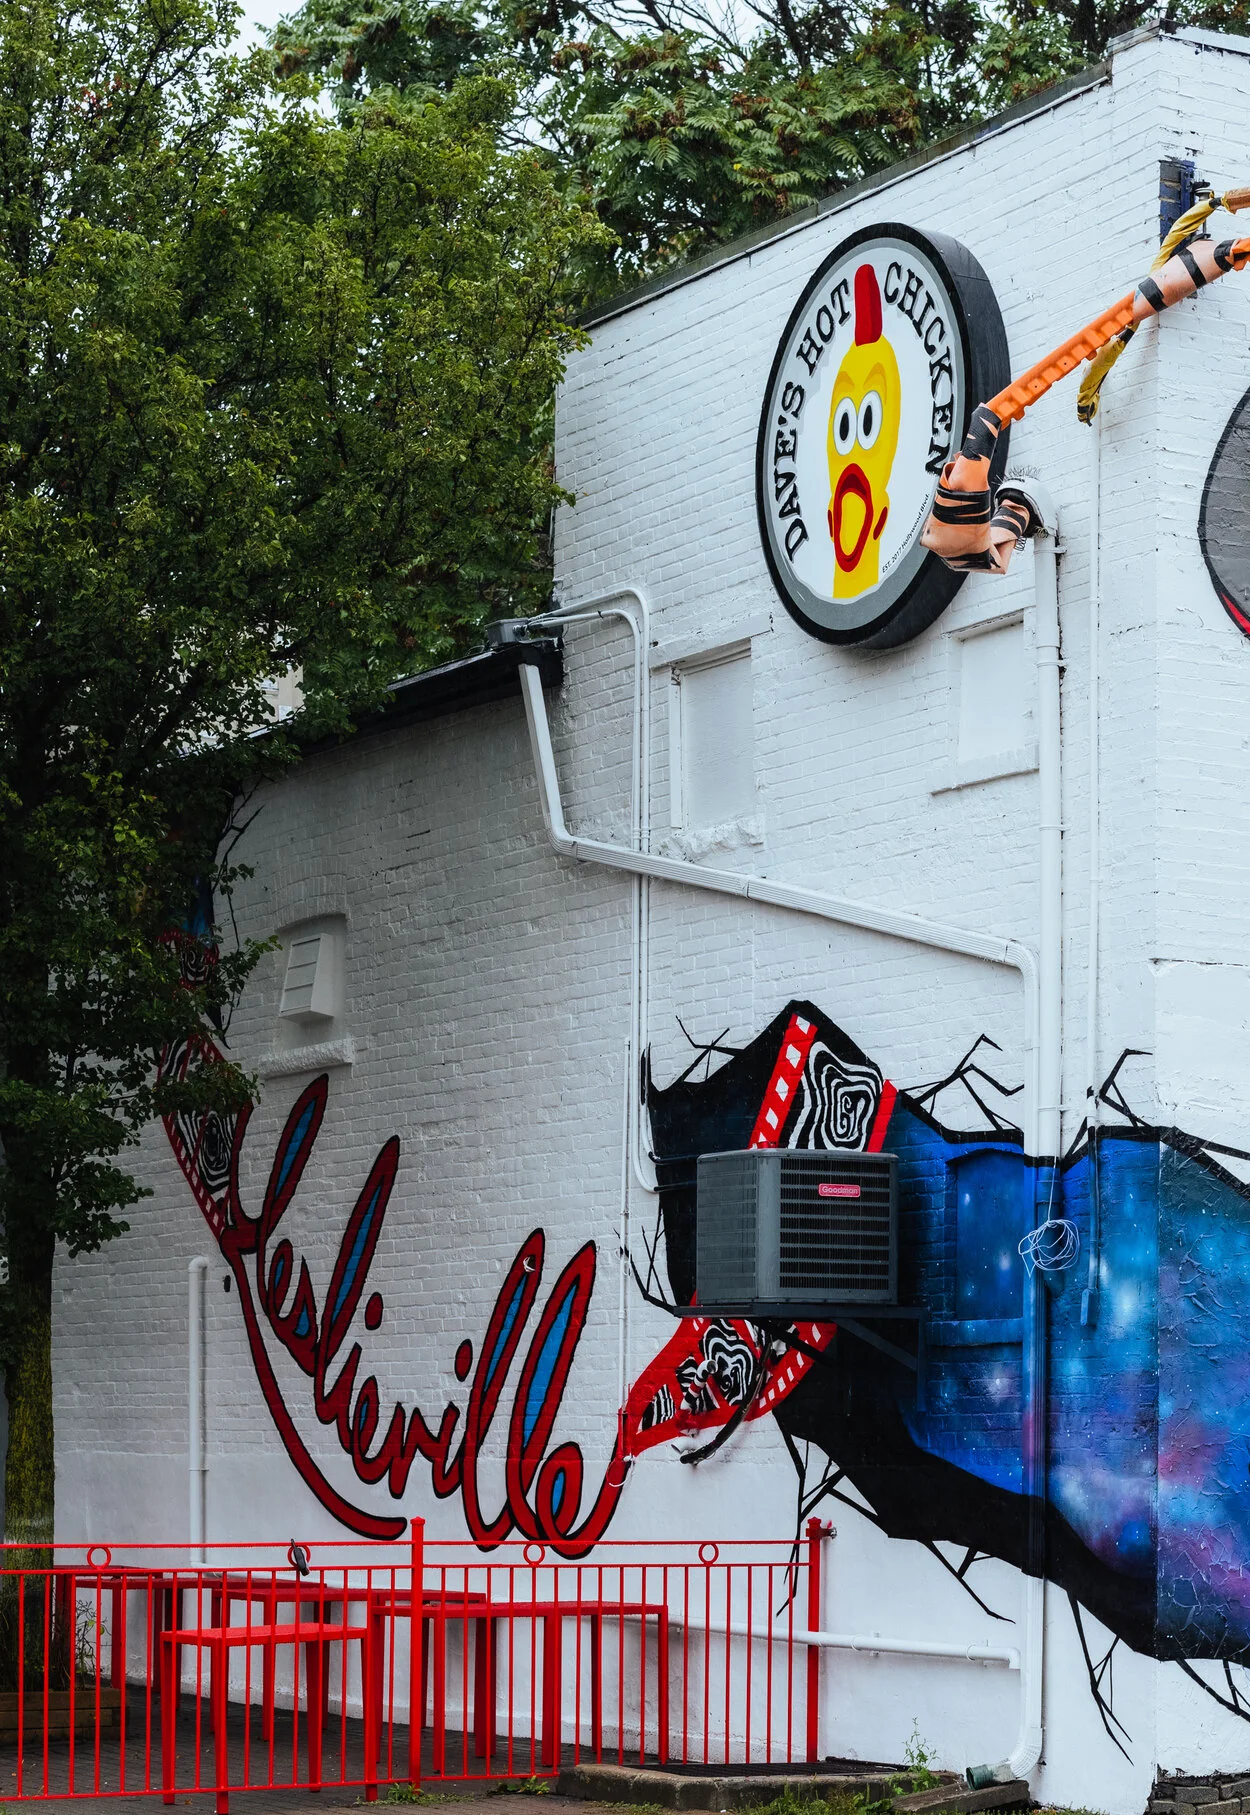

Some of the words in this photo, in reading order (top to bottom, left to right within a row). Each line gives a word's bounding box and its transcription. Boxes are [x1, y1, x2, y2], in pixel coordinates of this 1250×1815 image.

[774, 381, 809, 562] DAVE'S
[797, 279, 850, 376] HOT
[884, 261, 955, 476] CHICKEN
[891, 547, 902, 563] 2017
[901, 511, 922, 550] Hollywood
[920, 493, 930, 514] Blvd.
[822, 1186, 858, 1194] Goodman
